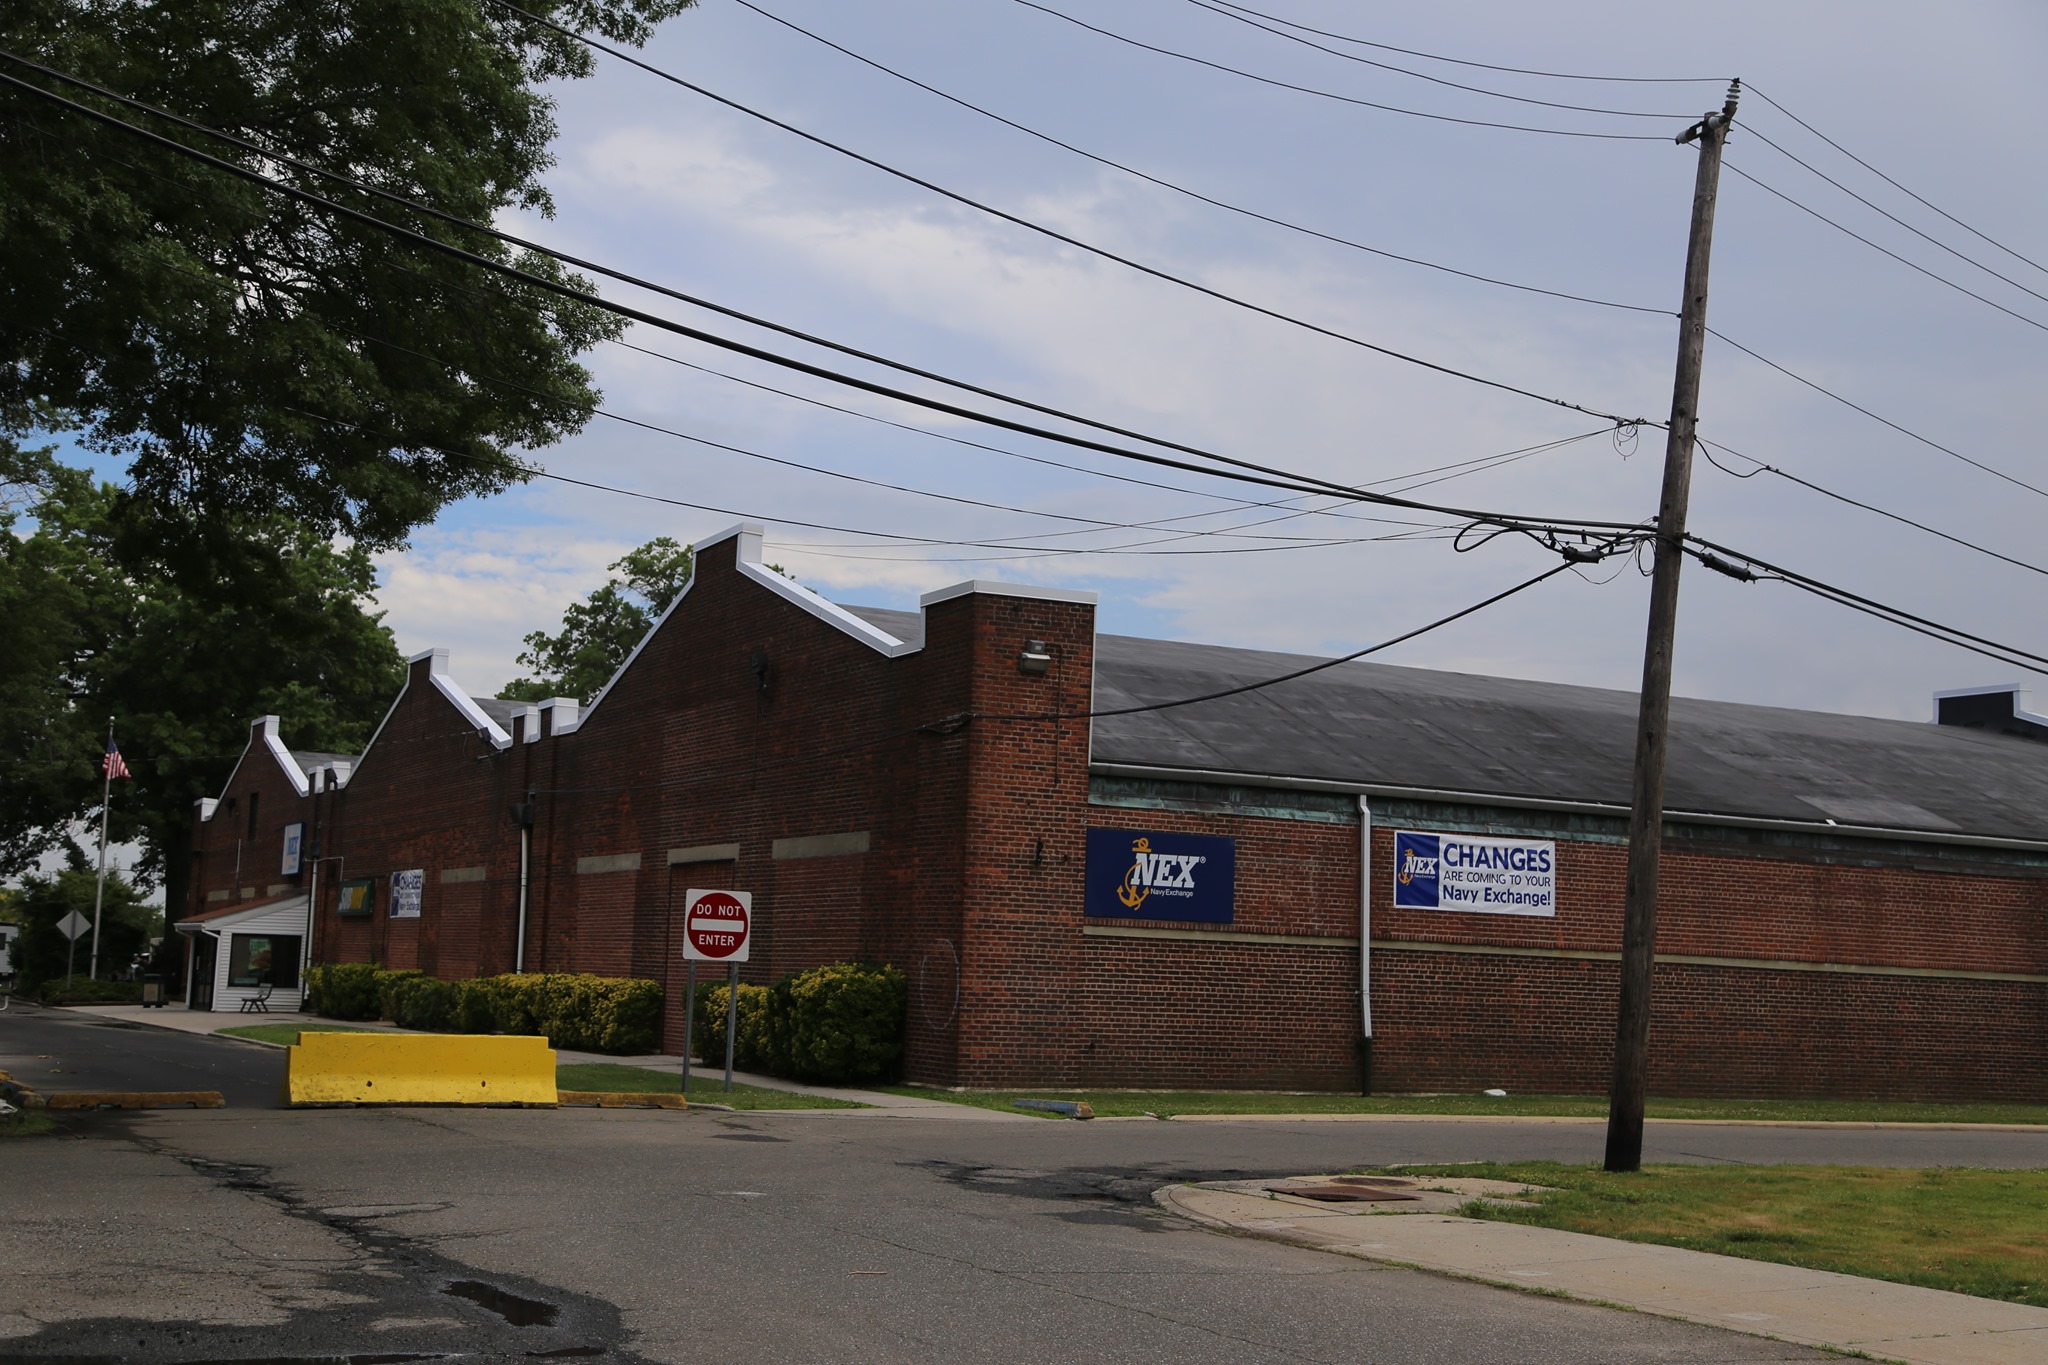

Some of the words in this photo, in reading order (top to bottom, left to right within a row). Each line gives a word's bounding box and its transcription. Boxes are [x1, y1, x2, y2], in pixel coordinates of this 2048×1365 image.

[1403, 856, 1438, 875] NEX
[1443, 843, 1551, 872] CHANGES
[1130, 852, 1200, 888] NEX
[1443, 871, 1463, 882] ARE
[1466, 872, 1506, 885] COMING
[1509, 875, 1522, 886] TO
[1525, 875, 1551, 887] YOUR
[1150, 888, 1166, 896] Navy
[1165, 889, 1194, 898] Exchange
[1443, 885, 1479, 903] Navy
[1484, 887, 1551, 907] Exchange!
[697, 904, 712, 915] DO
[718, 905, 741, 916] NOT
[698, 934, 735, 946] ENTER
